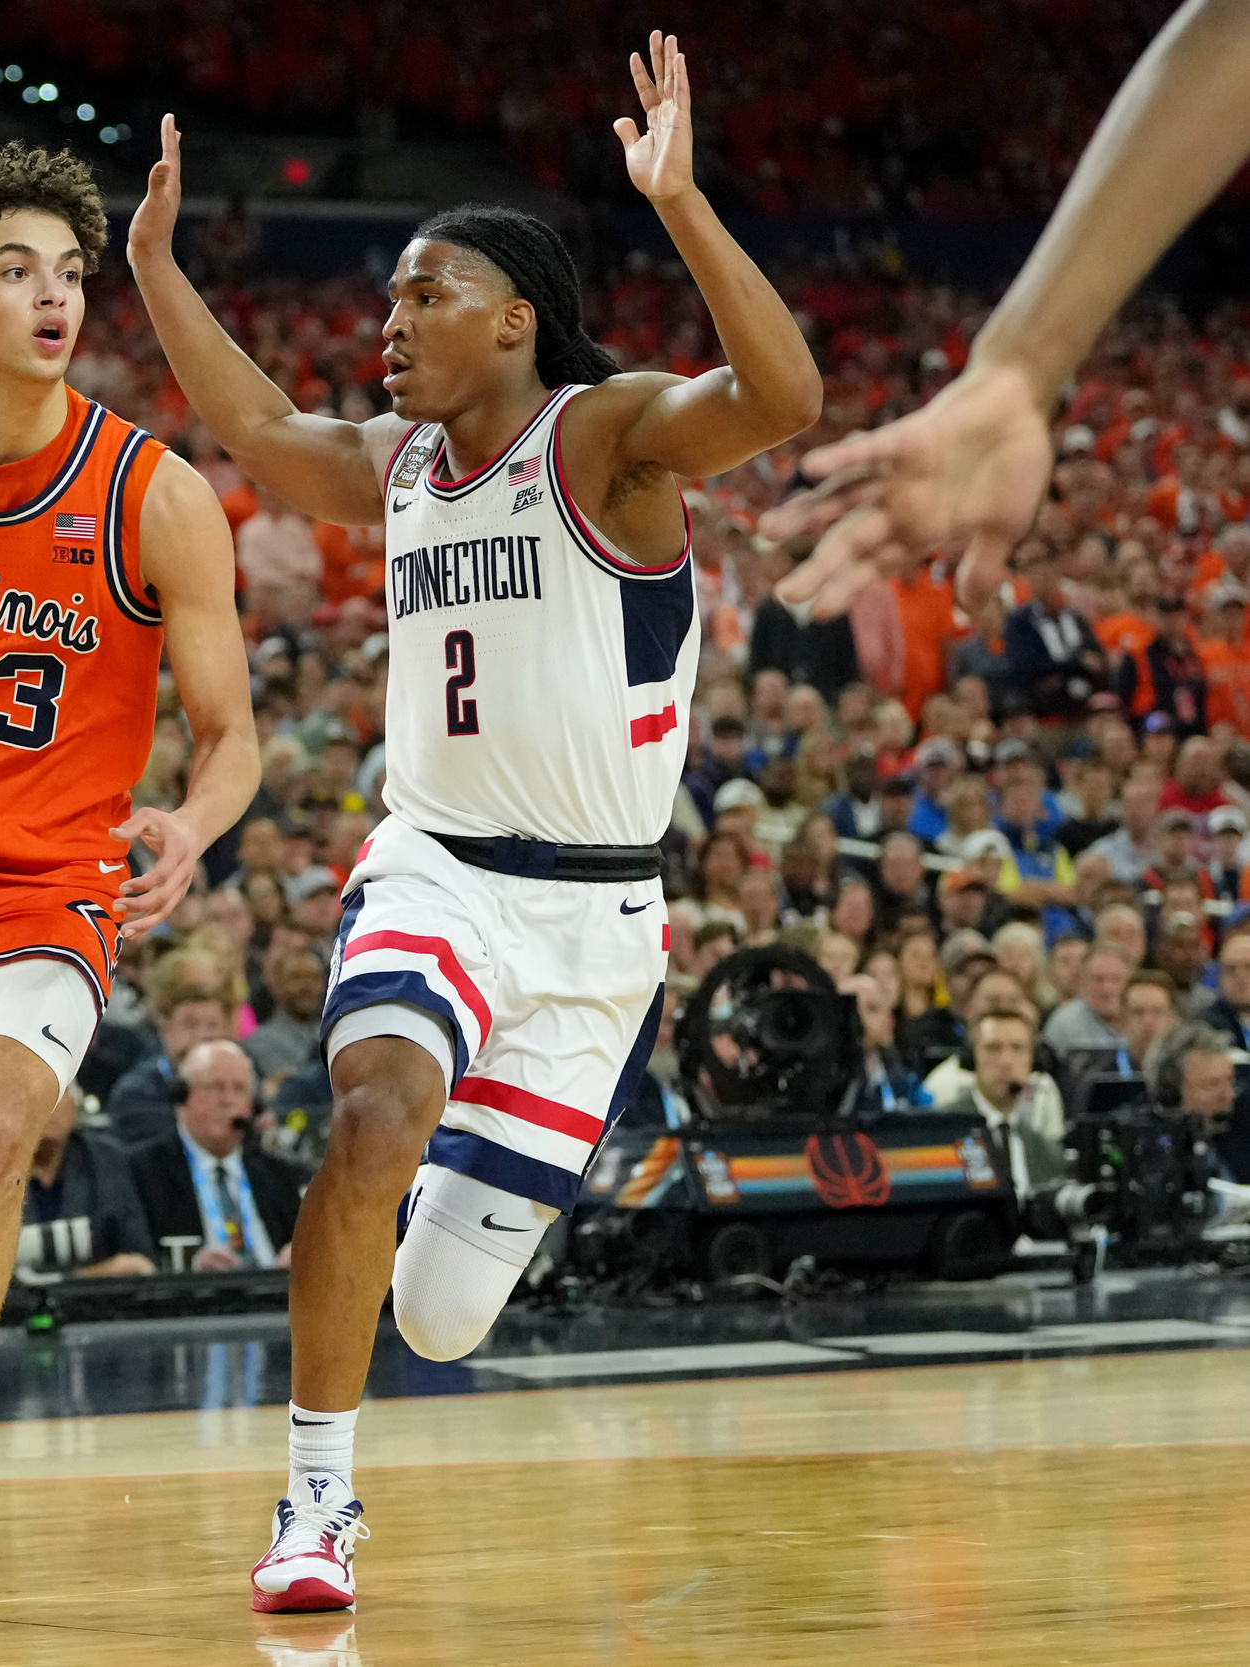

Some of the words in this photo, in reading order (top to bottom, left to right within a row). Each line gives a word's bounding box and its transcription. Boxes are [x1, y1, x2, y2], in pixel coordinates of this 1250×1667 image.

[407, 453, 427, 464] FINAL
[398, 471, 418, 481] FOUR
[513, 491, 544, 510] EAST
[516, 484, 538, 501] BIG
[391, 536, 542, 620] CONNECTICUT
[445, 630, 479, 736] 2
